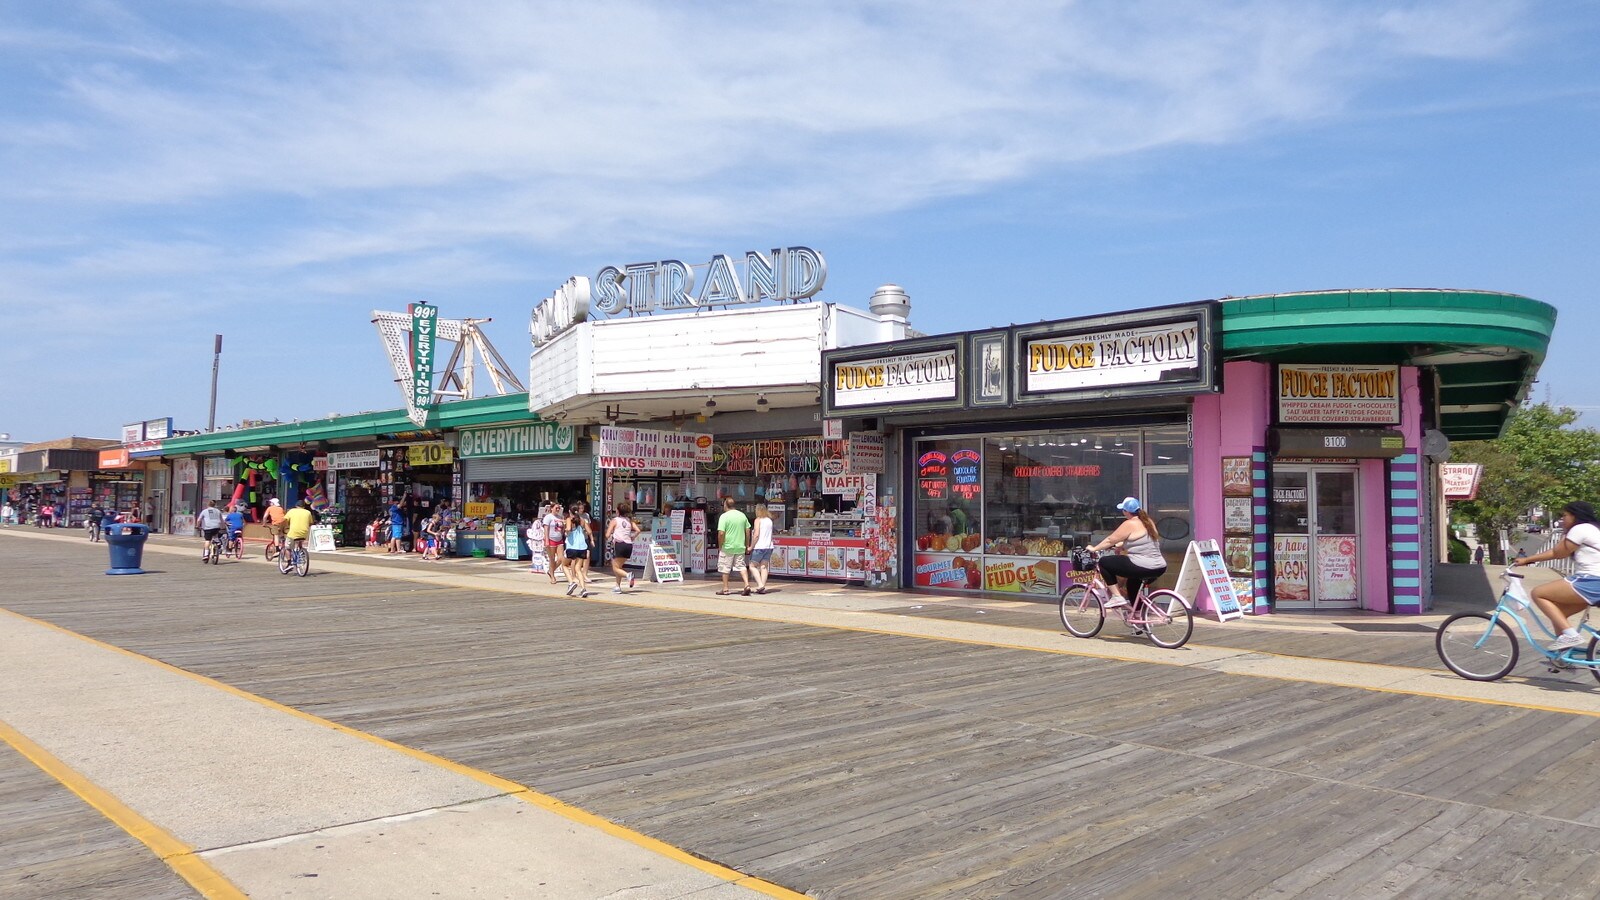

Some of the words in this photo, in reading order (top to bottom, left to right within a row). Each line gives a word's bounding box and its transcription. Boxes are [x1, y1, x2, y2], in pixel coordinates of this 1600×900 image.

[595, 246, 828, 315] STRAND
[414, 306, 436, 319] 99¢
[1085, 333, 1111, 341] FRESHLY
[418, 320, 431, 395] EVERYTHING
[1029, 342, 1095, 373] FUDGE
[1100, 327, 1197, 367] FACTORY
[836, 365, 884, 391] FUDGE
[886, 354, 956, 386] FACTORY
[1281, 369, 1328, 398] FUDGE
[1332, 370, 1396, 398] FACTORY
[474, 425, 553, 454] EVERYTHING
[602, 429, 618, 441] CURLY
[636, 430, 660, 442] Funnel
[665, 433, 680, 444] cake
[1324, 436, 1346, 447] 3100
[421, 445, 442, 462] 10
[758, 441, 785, 456] FRIED
[790, 439, 825, 455] COTTON
[600, 456, 645, 468] WINGS
[757, 458, 786, 473] OREOS
[790, 456, 825, 473] CANDY
[1443, 467, 1473, 476] STRAND
[864, 484, 875, 515] CAKE
[1285, 538, 1306, 551] have
[916, 560, 952, 573] GOURMET
[985, 562, 1014, 572] Delicious
[1274, 561, 1308, 580] ACON
[929, 567, 966, 585] APPLES
[986, 565, 1037, 587] FUDGE
